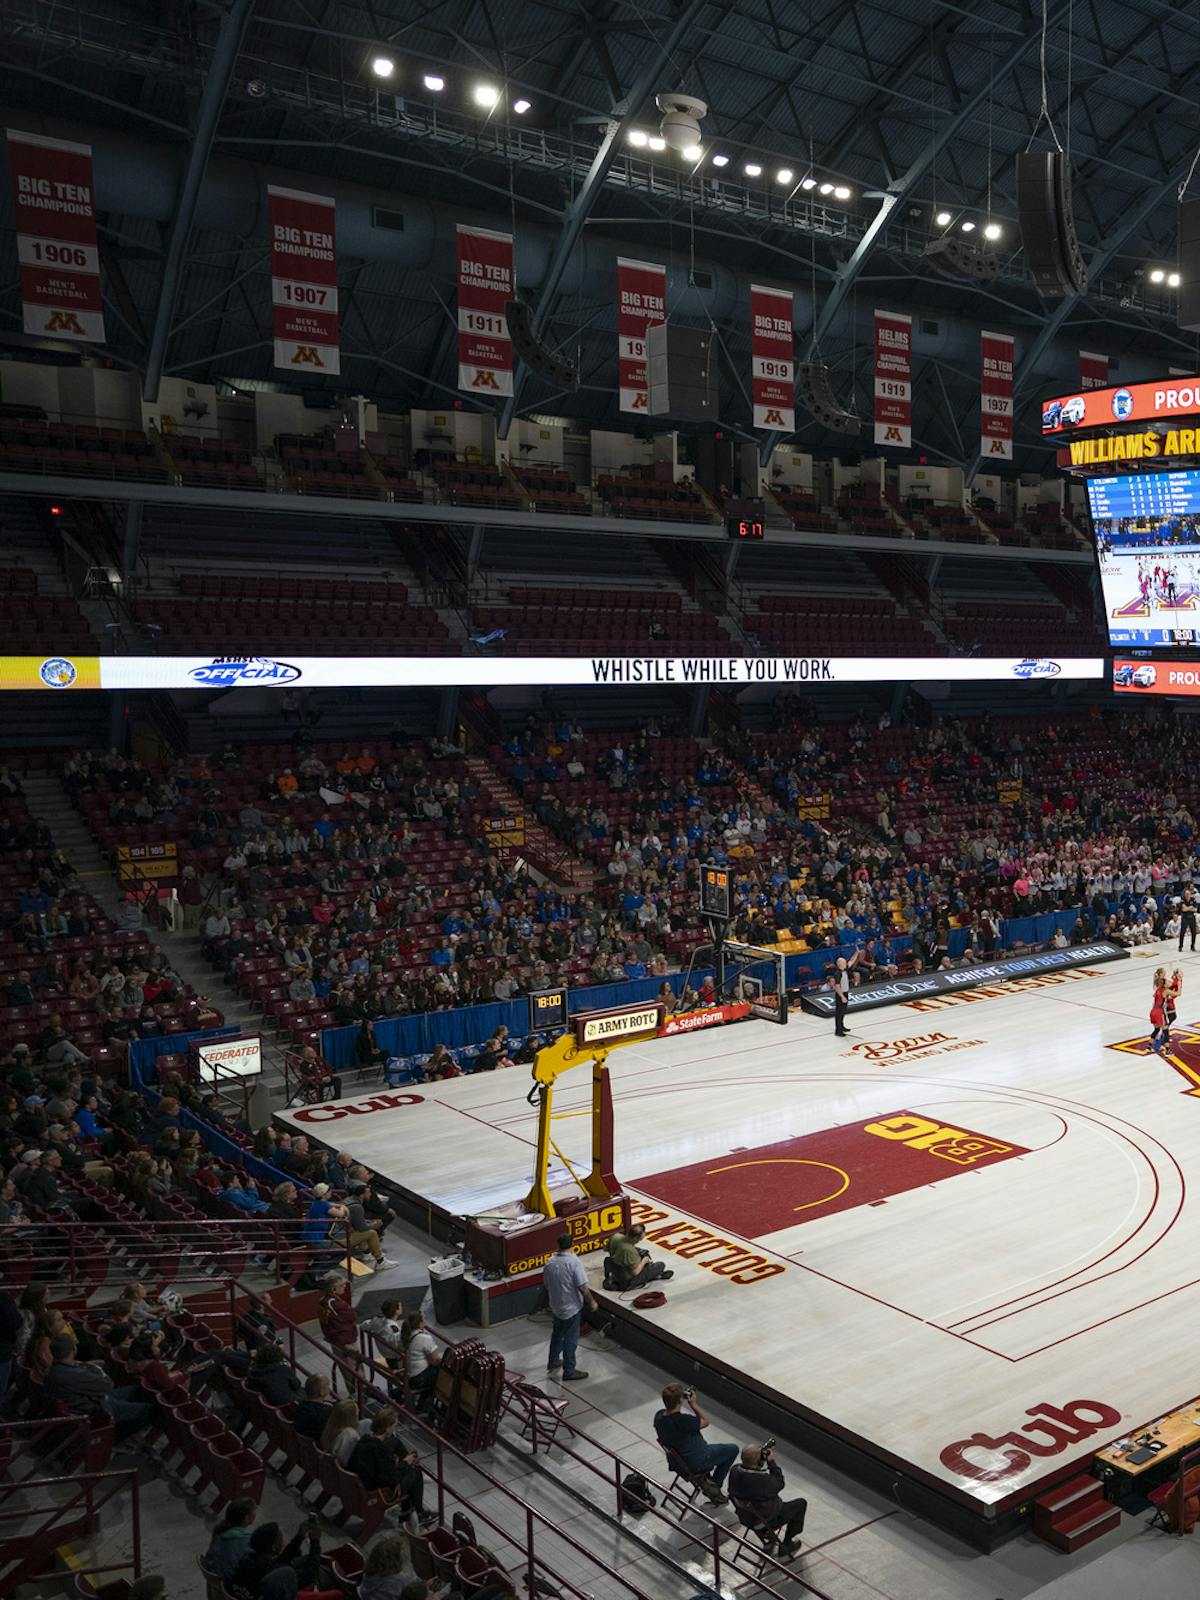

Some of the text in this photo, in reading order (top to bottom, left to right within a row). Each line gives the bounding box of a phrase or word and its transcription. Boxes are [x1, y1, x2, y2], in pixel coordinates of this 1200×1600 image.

[18, 175, 91, 203] BIG TEN
[18, 194, 93, 217] CHAMPIONS
[273, 224, 333, 249] BIG TEN
[32, 243, 87, 267] 1906
[273, 241, 335, 262] CHAMPIONS
[460, 259, 510, 282] BIG TEN
[35, 285, 89, 300] BASKETBALL
[48, 279, 76, 290] MEN'S
[460, 275, 512, 293] CHAMPIONS
[284, 284, 327, 305] 1907
[621, 290, 664, 310] BIG TEN
[621, 304, 665, 320] CHAMPIONS
[45, 311, 87, 335] M
[285, 323, 329, 336] BASKETBALL
[467, 314, 502, 333] 1911
[754, 314, 792, 333] BIG TEN
[754, 328, 793, 343] CHAMPIONS
[879, 327, 910, 344] HELMS
[291, 345, 324, 366] M
[983, 357, 1013, 373] BIG TEN
[472, 370, 500, 389] M
[761, 362, 788, 377] 1919
[881, 382, 905, 397] 1919
[988, 399, 1009, 412] 1937
[764, 409, 785, 426] M
[884, 427, 903, 441] M
[1069, 432, 1159, 465] WILLIAMS
[193, 668, 295, 679] OFFICIAL
[592, 659, 835, 682] WHISTLE WHILE YOU WORK.
[816, 944, 1116, 1009] PferredOne ACHIEVE YOUR BEST HEALTH
[903, 968, 1106, 1012] MINNESOTA
[538, 994, 561, 1008] 18:00
[598, 1012, 655, 1034] ARMY ROTC
[204, 1045, 259, 1062] FEDERATED
[852, 1032, 958, 1060] Barn
[872, 1040, 988, 1067] WILLIAMS ARENA
[293, 1094, 425, 1122] Cub
[646, 1221, 787, 1286] GOLDEN
[940, 1400, 1122, 1482] Cub
